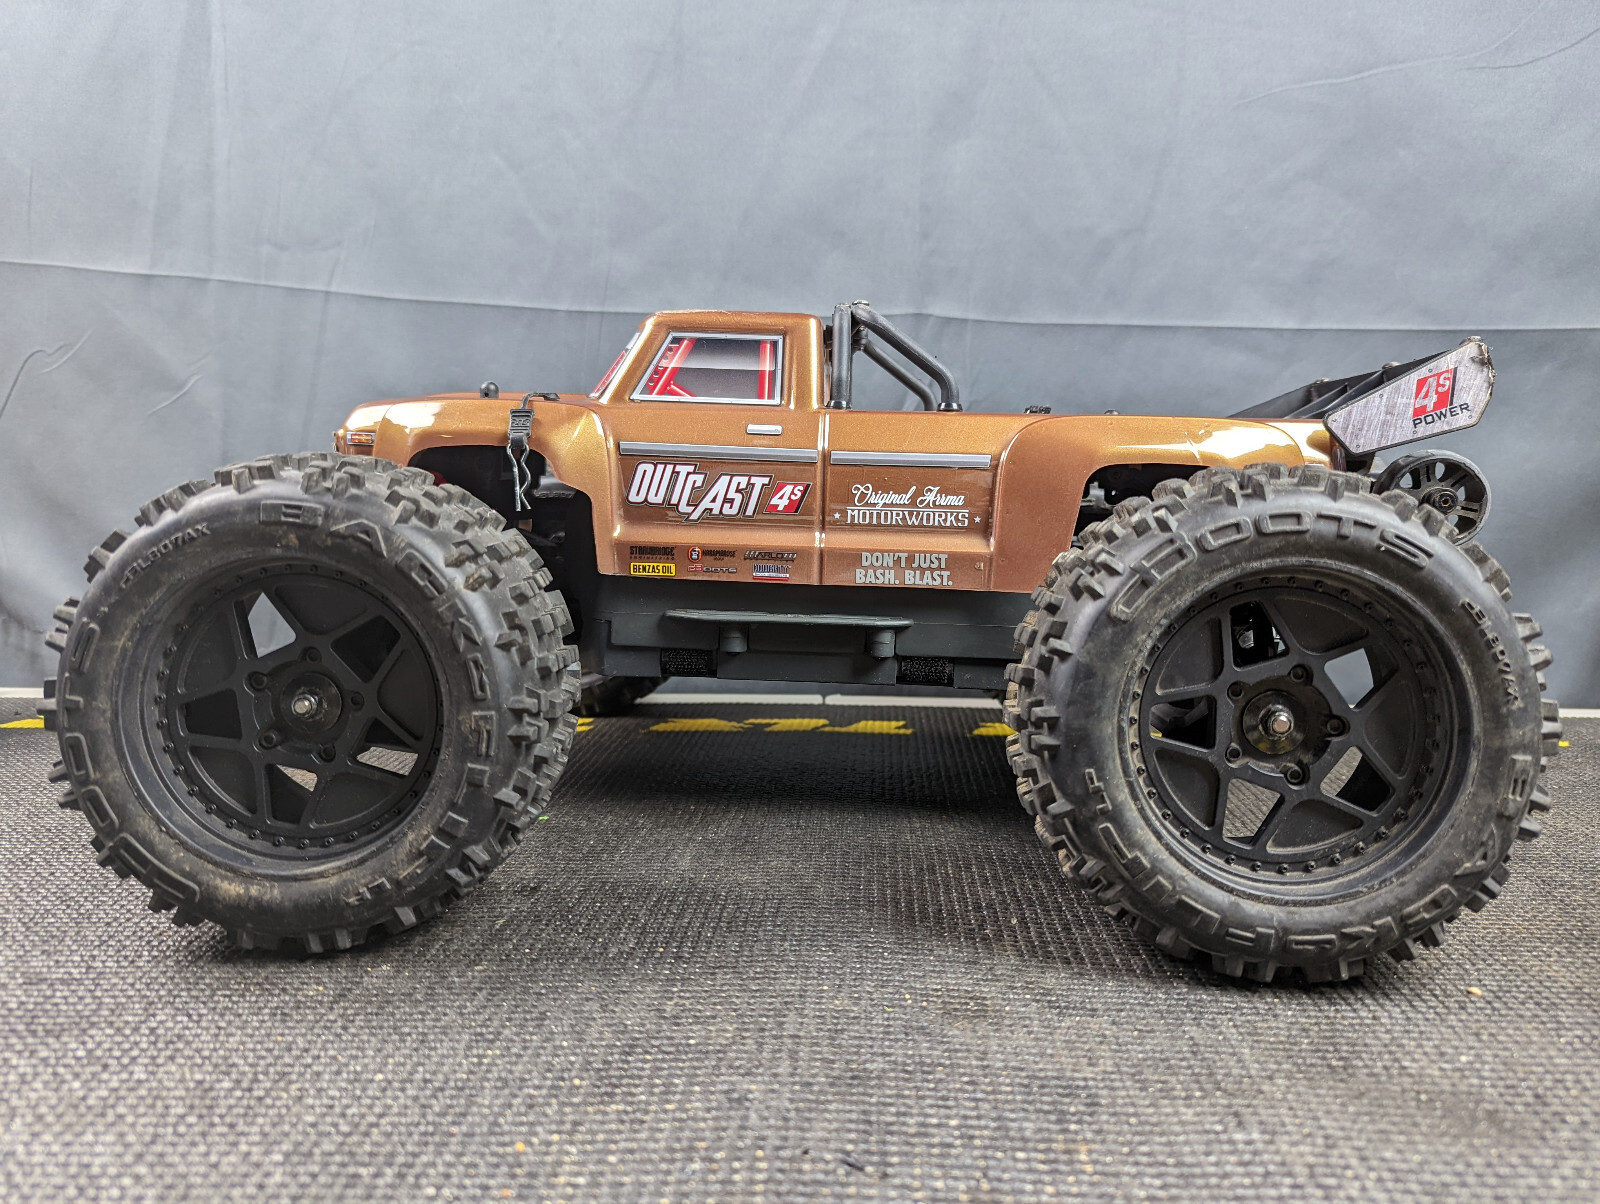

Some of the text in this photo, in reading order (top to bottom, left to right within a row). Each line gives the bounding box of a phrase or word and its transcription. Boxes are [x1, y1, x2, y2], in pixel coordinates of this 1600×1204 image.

[1411, 402, 1471, 429] POWER
[625, 461, 772, 522] OUTCAST
[851, 483, 966, 508] Original Arrma
[845, 509, 969, 527] MOTORWORKS
[632, 563, 674, 575] BENZAS OIL
[861, 551, 949, 570] DON'T JUST
[855, 569, 954, 587] BASH. BLAST.
